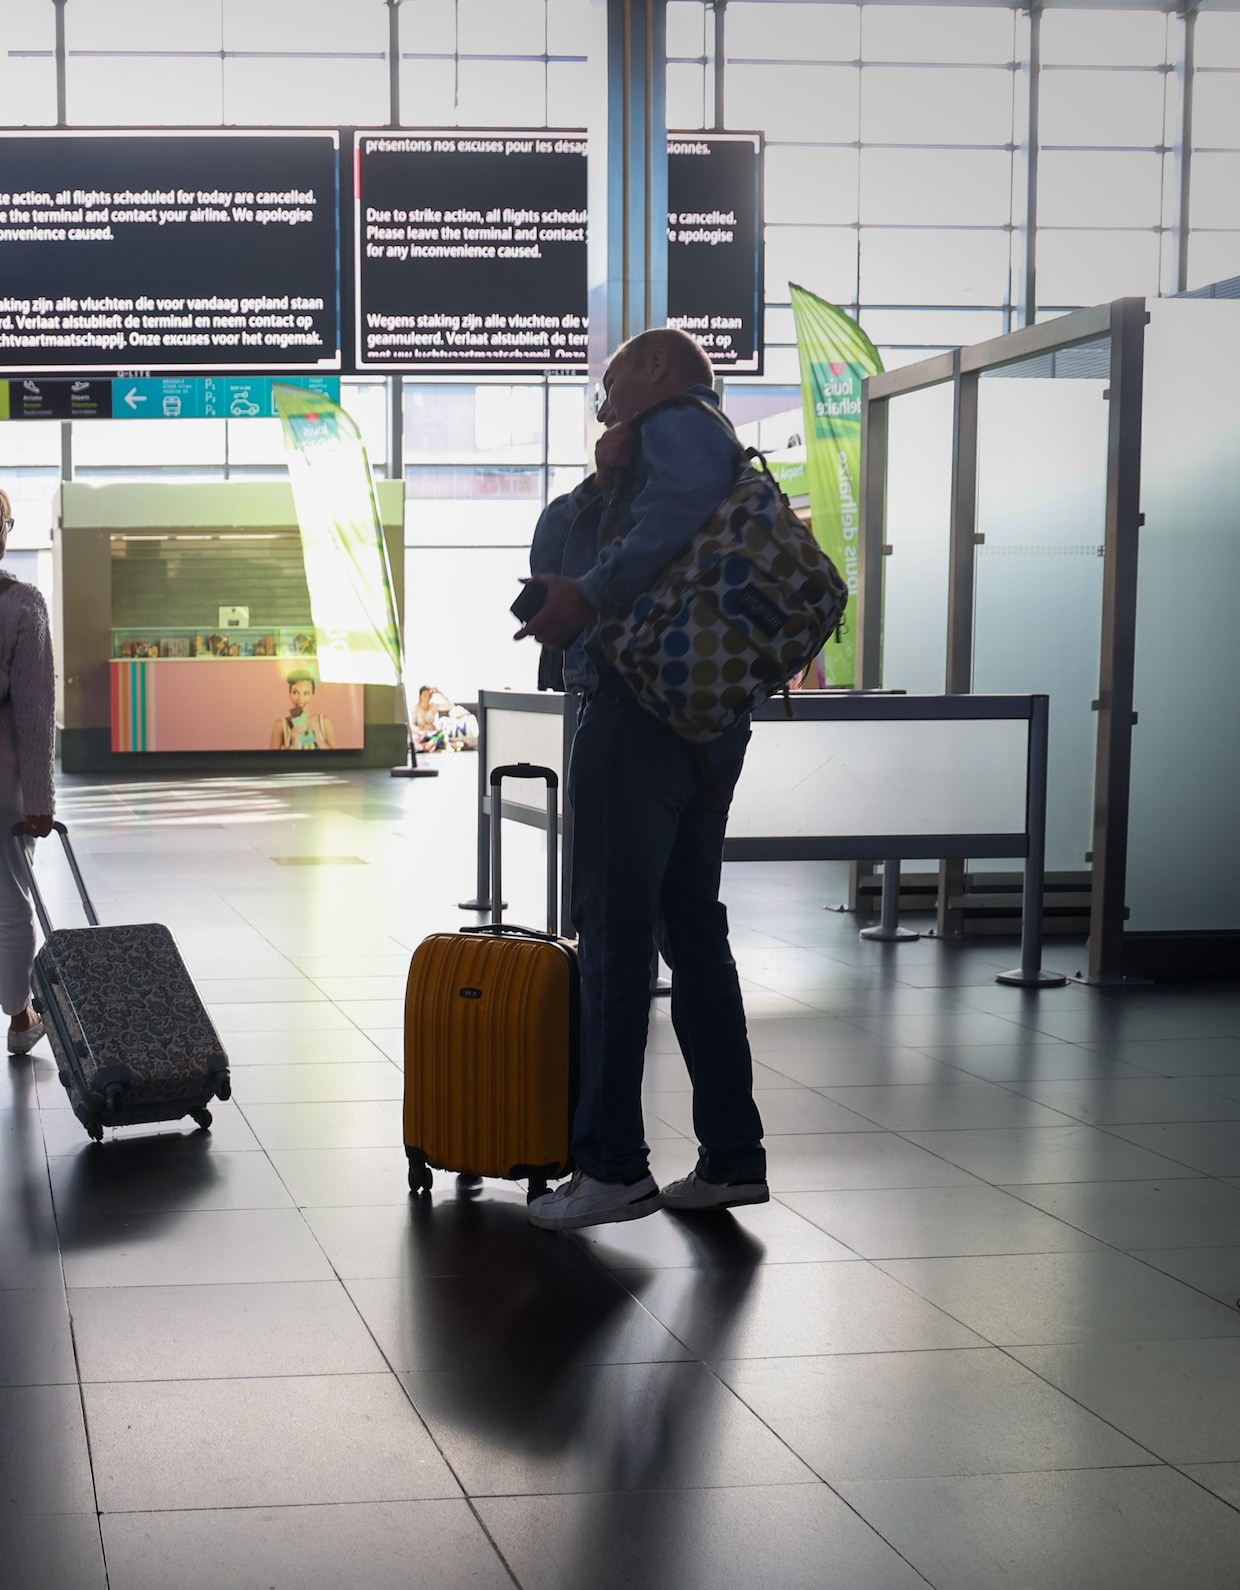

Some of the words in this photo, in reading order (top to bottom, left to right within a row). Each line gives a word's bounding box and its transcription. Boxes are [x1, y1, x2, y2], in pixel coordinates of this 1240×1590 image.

[366, 139, 433, 155] présentons
[432, 141, 456, 152] nos
[456, 141, 504, 152] excuses
[504, 141, 533, 156] pour
[535, 140, 553, 153] les
[11, 191, 54, 207] action,
[55, 190, 72, 205] all
[72, 190, 112, 207] flights
[112, 190, 176, 204] scheduled
[176, 190, 196, 204] for
[196, 190, 233, 207] today
[233, 192, 255, 204] are
[255, 190, 316, 204] cancelled.
[8, 208, 31, 223] the
[31, 208, 84, 223] terminal
[84, 207, 110, 222] and
[110, 209, 158, 222] contact
[158, 211, 188, 226] your
[189, 207, 231, 222] airline.
[231, 207, 254, 221] We
[255, 207, 313, 226] apologise
[367, 208, 392, 222] Due
[393, 209, 407, 222] to
[408, 208, 442, 222] strike
[443, 208, 485, 225] action,
[485, 209, 501, 222] all
[502, 208, 540, 226] flights
[678, 211, 737, 225] cancelled.
[67, 226, 114, 240] caused.
[367, 225, 406, 240] Please
[406, 226, 439, 240] leave
[440, 226, 462, 240] the
[462, 226, 513, 240] terminal
[514, 225, 538, 240] and
[538, 228, 584, 241] contact
[678, 228, 733, 245] apologise
[366, 243, 384, 257] for
[386, 246, 409, 261] any
[410, 243, 496, 258] inconvenience
[497, 244, 542, 258] caused.
[31, 297, 54, 315] zijn
[55, 297, 79, 311] alle
[79, 297, 134, 311] vluchten
[135, 296, 155, 310] die
[156, 299, 185, 310] voor
[186, 296, 239, 314] vandaag
[239, 296, 289, 314] gepland
[290, 297, 323, 310] staan
[15, 314, 61, 329] Verlaat
[61, 314, 123, 329] alstublieft
[124, 314, 141, 328] de
[142, 314, 193, 328] terminal
[194, 317, 211, 328] en
[212, 316, 247, 328] neem
[248, 314, 295, 327] contact
[296, 316, 313, 331] op
[367, 314, 416, 332] Wegens
[416, 314, 461, 332] staking
[461, 314, 483, 332] zijn
[484, 314, 507, 328] alle
[508, 314, 560, 328] vluchten
[561, 314, 581, 328] die
[710, 316, 742, 329] staan
[128, 332, 161, 346] Onze
[162, 334, 210, 346] excuses
[211, 334, 240, 345] voor
[241, 331, 263, 345] het
[264, 331, 323, 349] ongemak.
[367, 330, 444, 349] geannuleerd.
[445, 330, 489, 345] Verlaat
[490, 331, 549, 345] alstublieft
[550, 332, 567, 345] de
[715, 335, 731, 350] op
[205, 378, 216, 390] P1
[205, 391, 216, 403] P2
